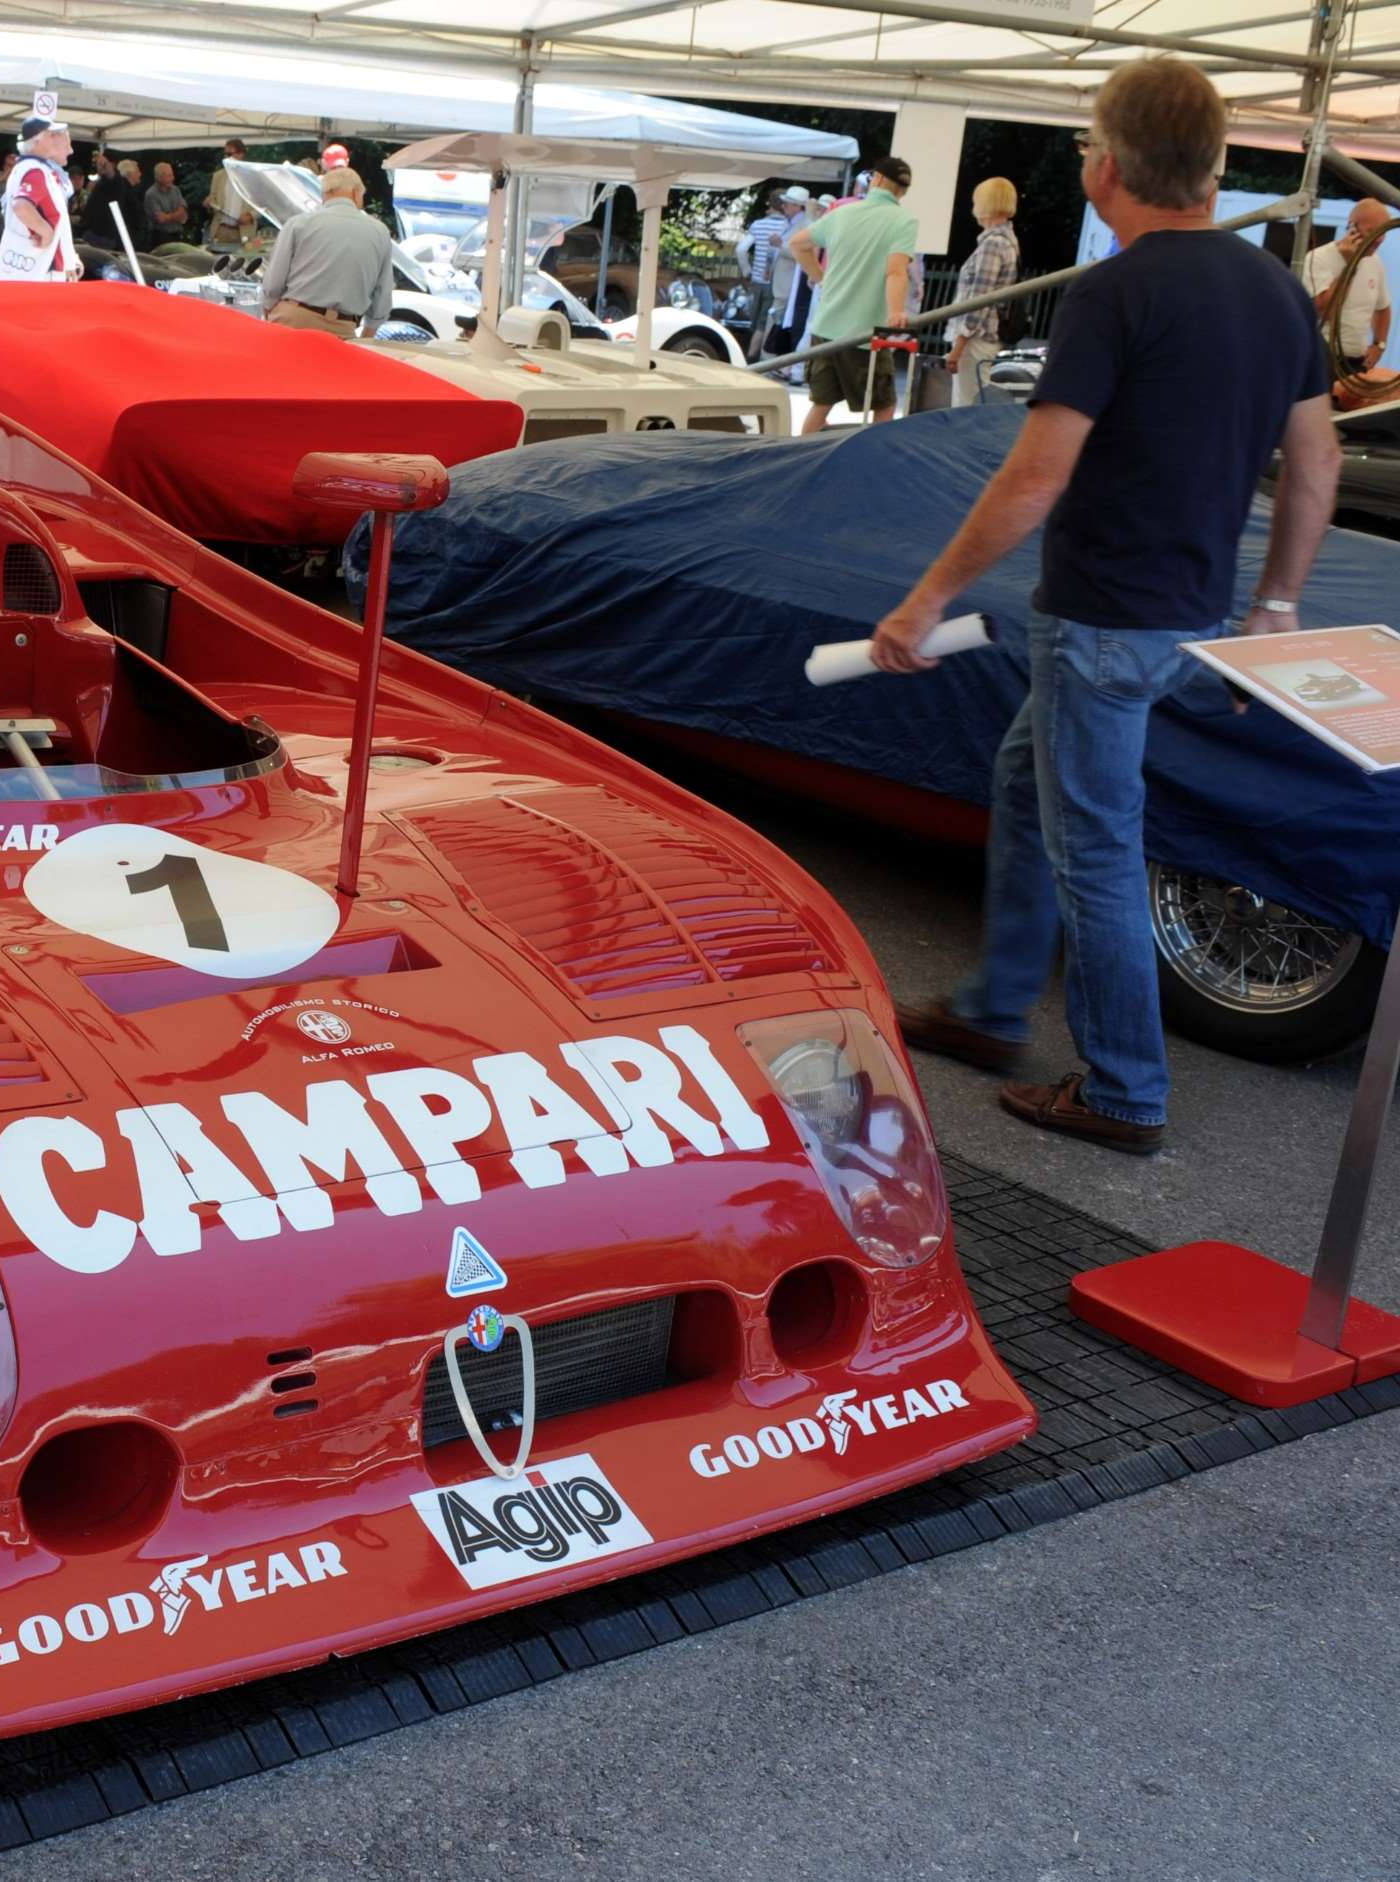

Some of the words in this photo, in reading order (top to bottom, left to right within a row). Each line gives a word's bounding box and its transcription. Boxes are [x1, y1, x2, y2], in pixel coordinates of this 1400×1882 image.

[125, 853, 230, 953] 1
[240, 999, 324, 1041] AUTOMOBILISMO
[331, 999, 400, 1018] STORICO
[302, 1053, 338, 1064] ALFA
[341, 1041, 395, 1057] ROMEO
[689, 1418, 826, 1478] GOOD
[842, 1379, 970, 1436] YEAR
[437, 1470, 622, 1566] Agip
[185, 1541, 348, 1612] YEAR
